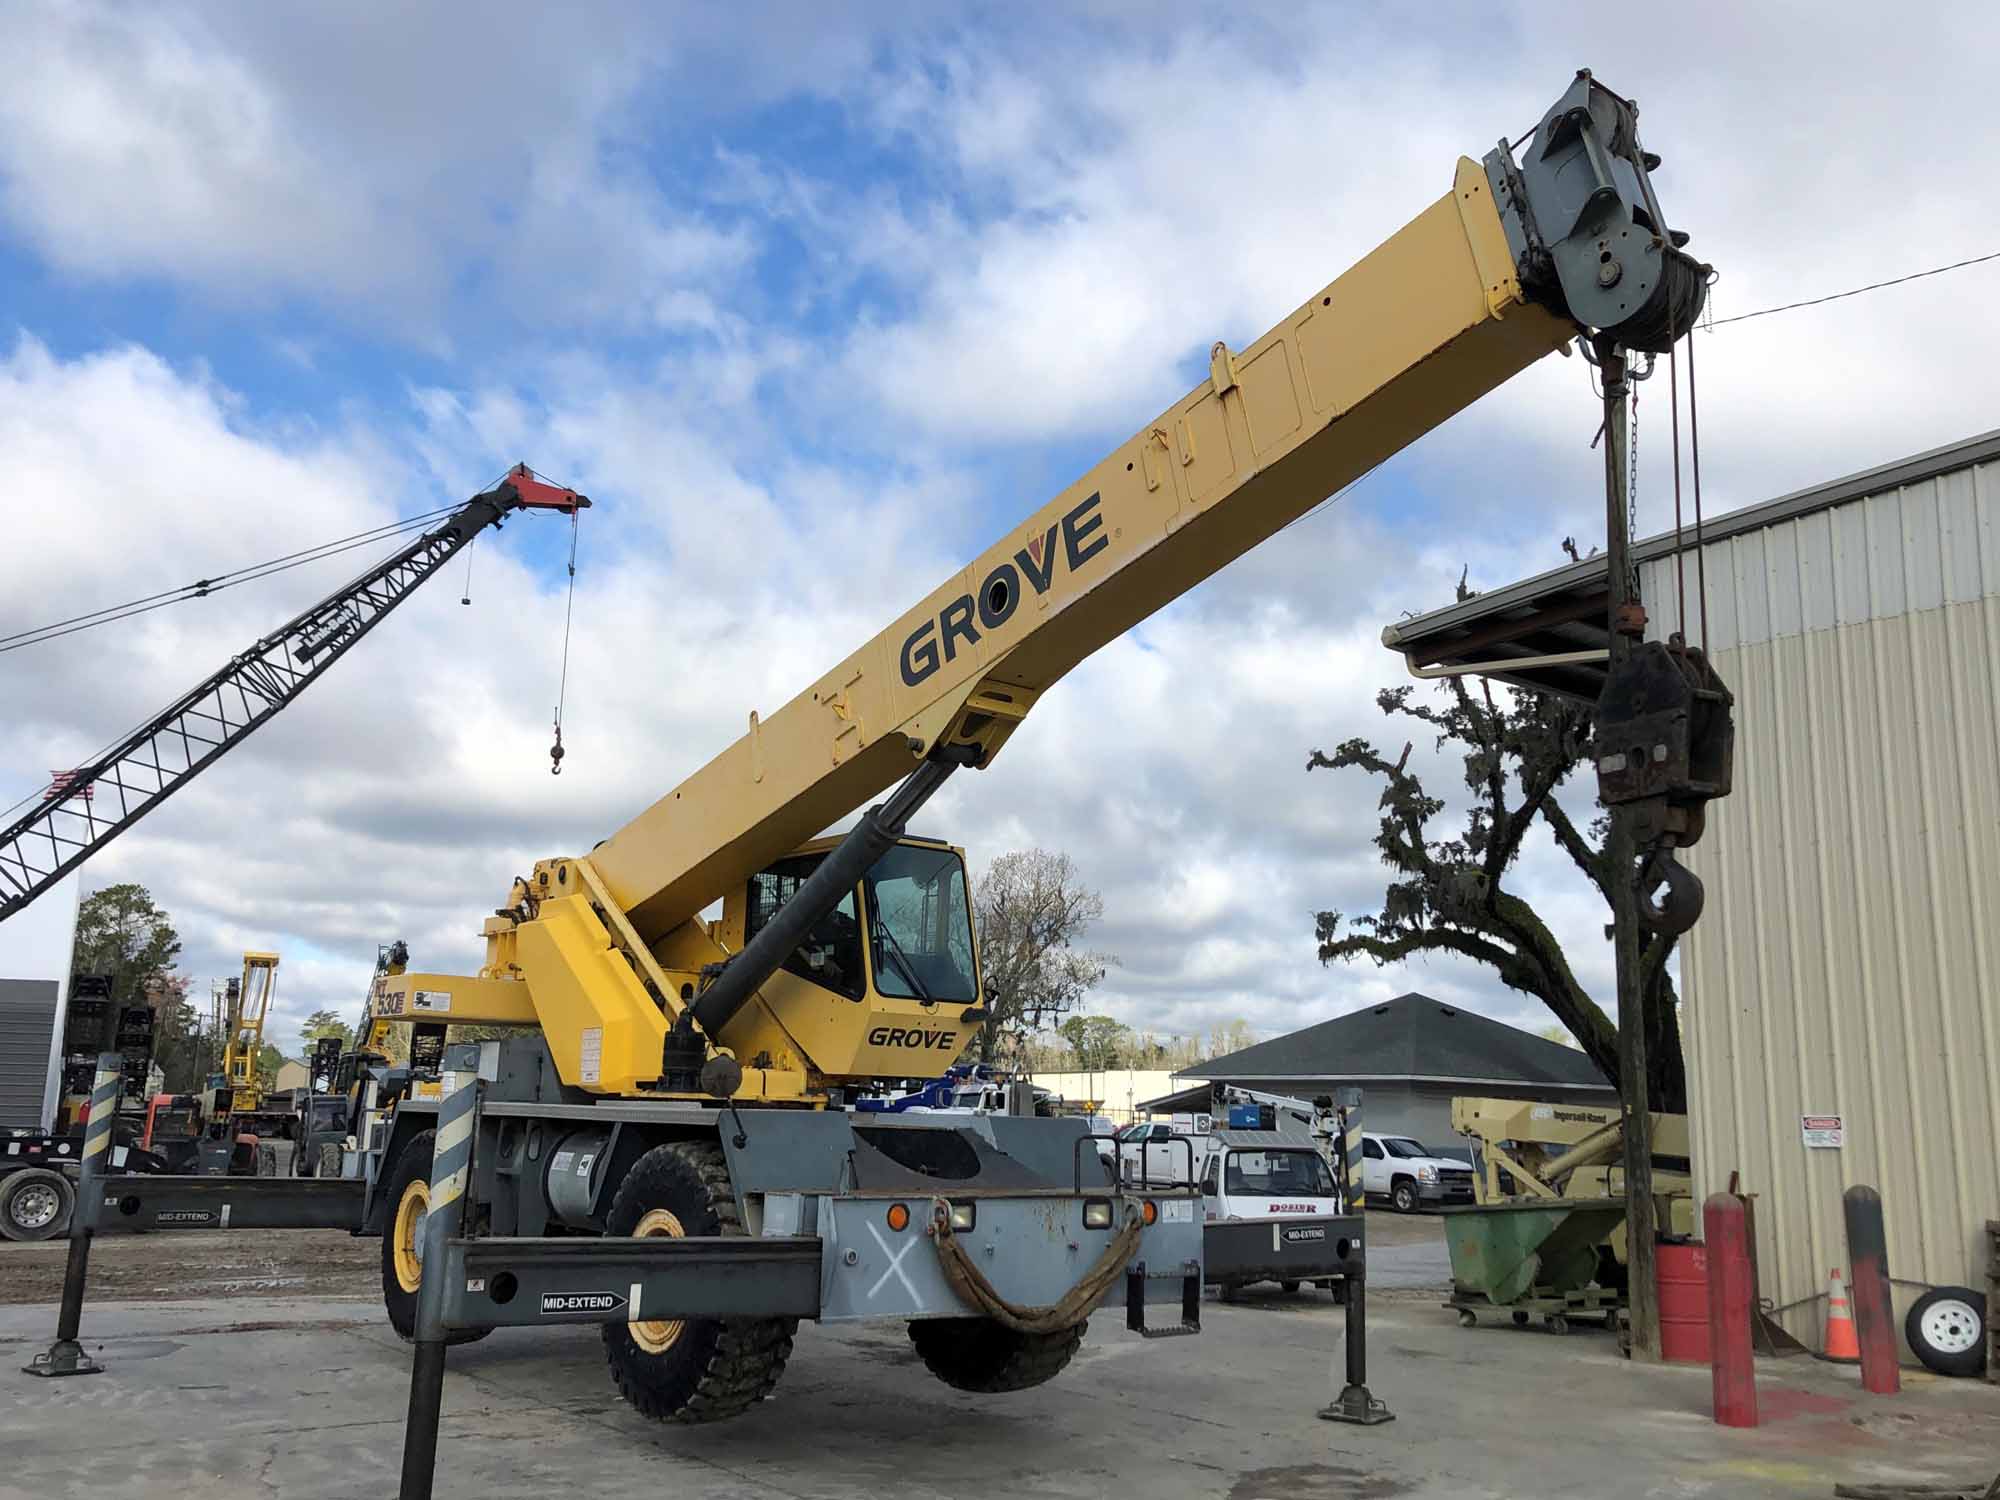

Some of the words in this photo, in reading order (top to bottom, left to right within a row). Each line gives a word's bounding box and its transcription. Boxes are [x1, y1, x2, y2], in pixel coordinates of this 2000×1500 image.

[900, 491, 1109, 687] GROVE
[868, 1027, 957, 1050] GROVE
[1288, 1229, 1325, 1240] MID-EXTEND
[543, 1296, 613, 1309] MID-EXTEND
